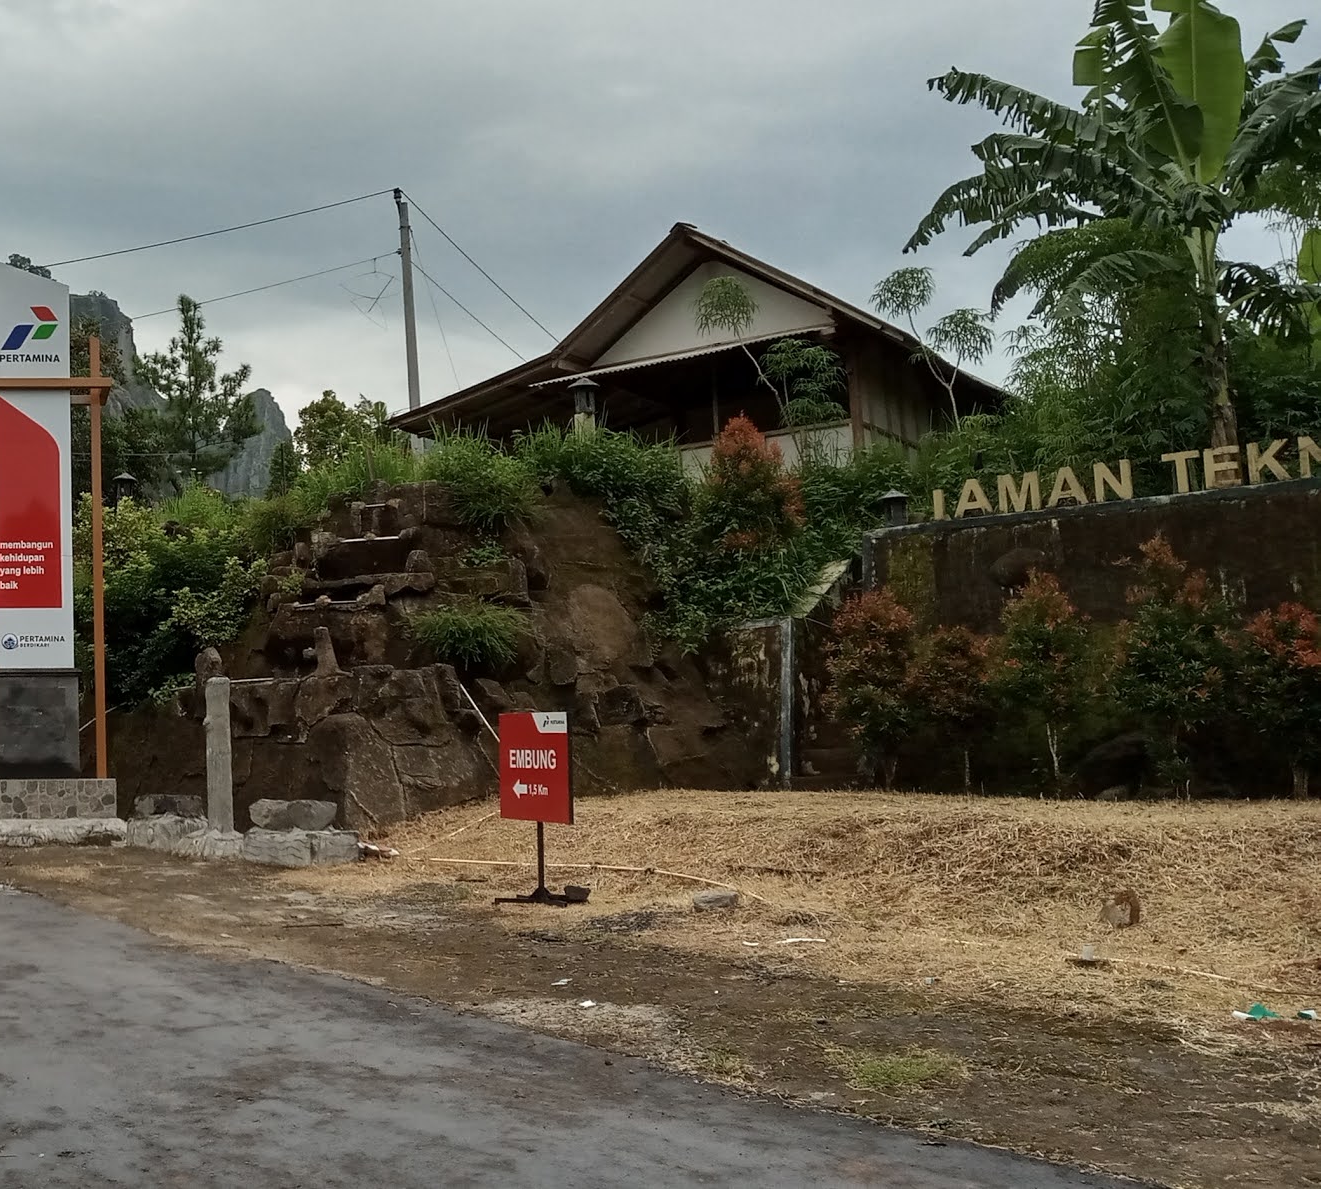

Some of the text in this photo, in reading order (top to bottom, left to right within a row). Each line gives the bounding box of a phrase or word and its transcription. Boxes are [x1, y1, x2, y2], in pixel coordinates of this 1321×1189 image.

[0, 354, 60, 363] PERTAMINA
[0, 540, 54, 551] membangun
[0, 553, 45, 564] kehidupan
[0, 565, 45, 577] yang lebih
[0, 580, 19, 590] baik
[19, 635, 65, 643] PERTAMINA
[509, 749, 557, 770] EMBUNG
[528, 784, 549, 797] 1,5 Km
